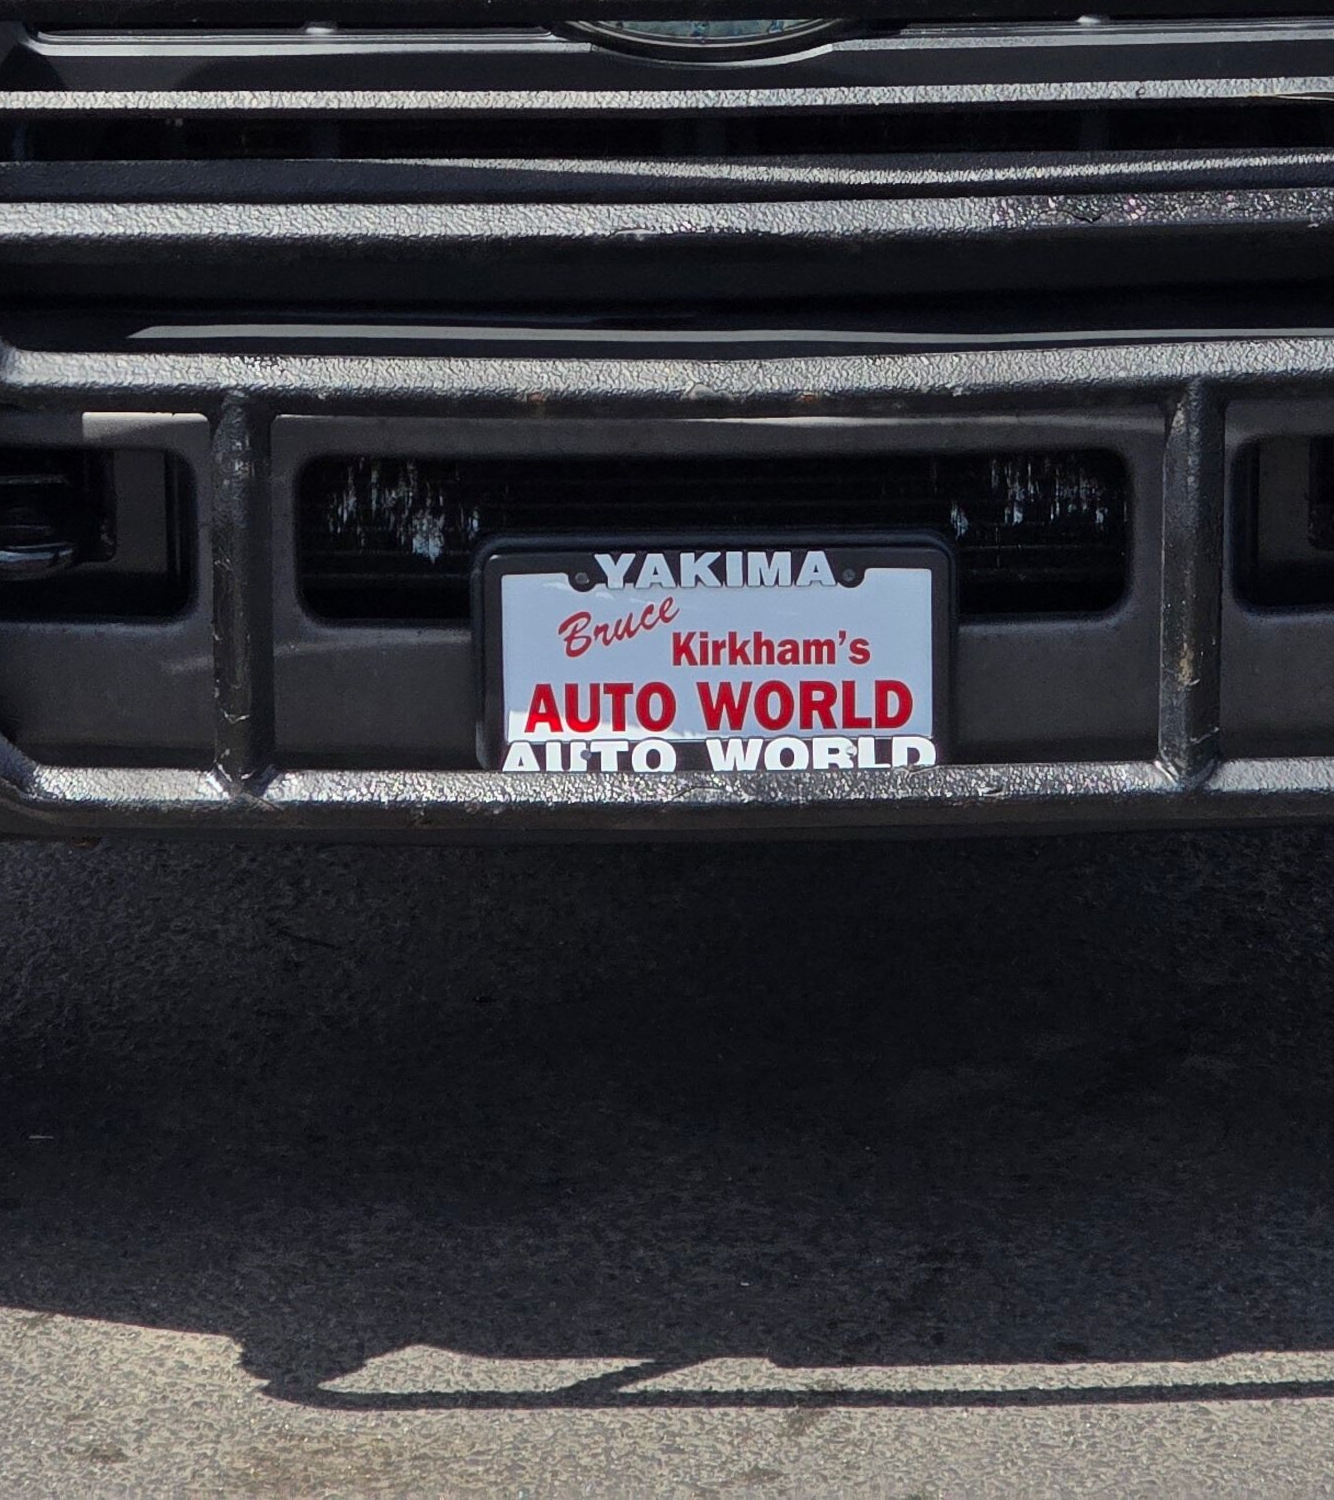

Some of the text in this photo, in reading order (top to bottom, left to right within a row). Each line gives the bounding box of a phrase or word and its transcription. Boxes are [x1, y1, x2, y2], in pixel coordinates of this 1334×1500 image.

[593, 550, 837, 590] YAKIMA
[557, 597, 680, 659] Bruce
[671, 630, 871, 667] Kirkham's
[524, 680, 914, 733] AUTO WORLD
[502, 736, 937, 773] AUTO WORLD
